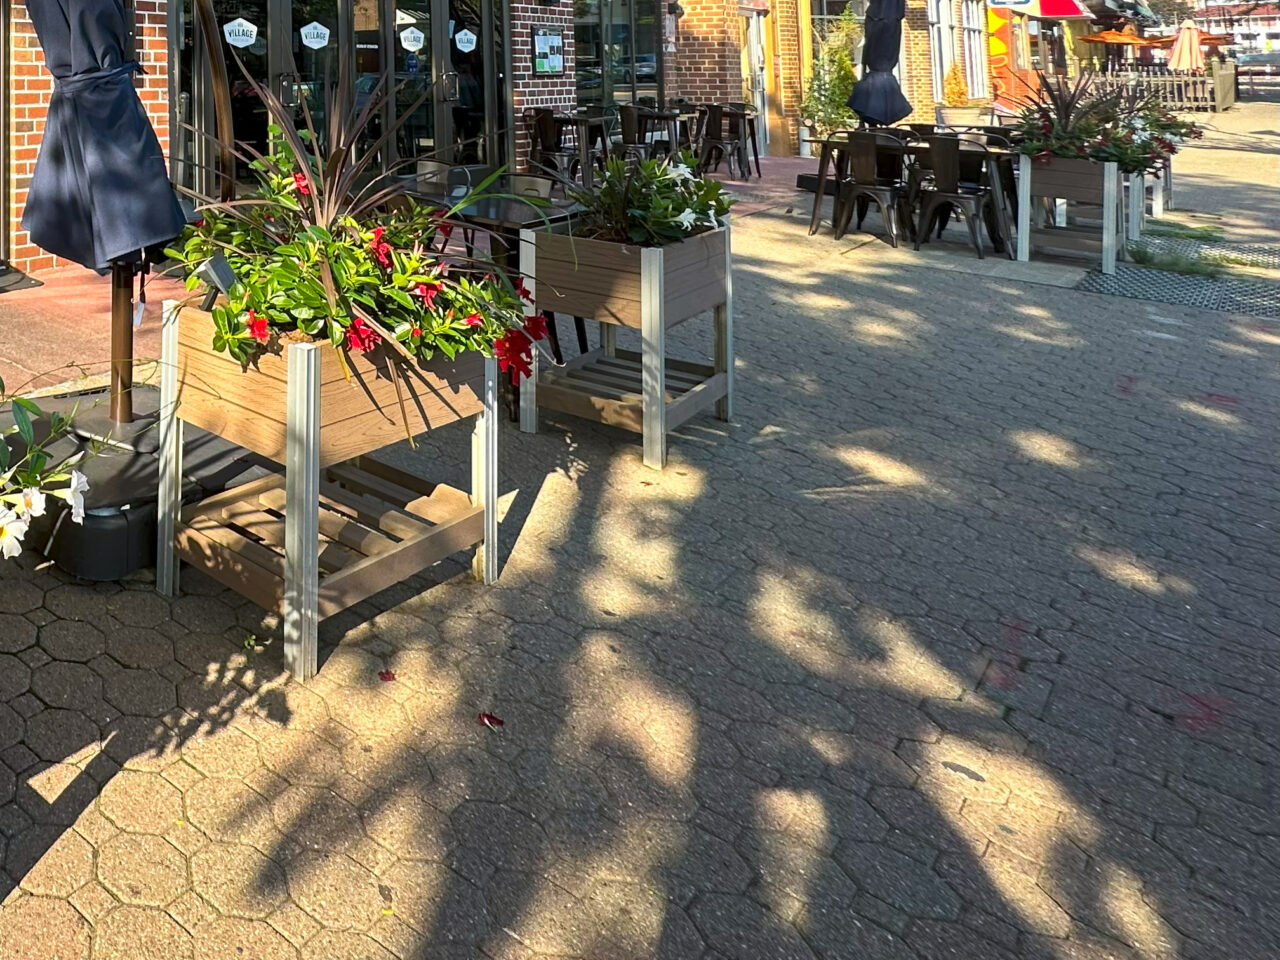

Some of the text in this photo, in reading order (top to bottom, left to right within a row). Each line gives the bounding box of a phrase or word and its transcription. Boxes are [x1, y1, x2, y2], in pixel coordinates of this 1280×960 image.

[227, 28, 254, 39] VILLAGE
[304, 31, 327, 41] VILLAGE
[403, 35, 422, 45] VILLAGE
[458, 37, 474, 45] VILLAGE
